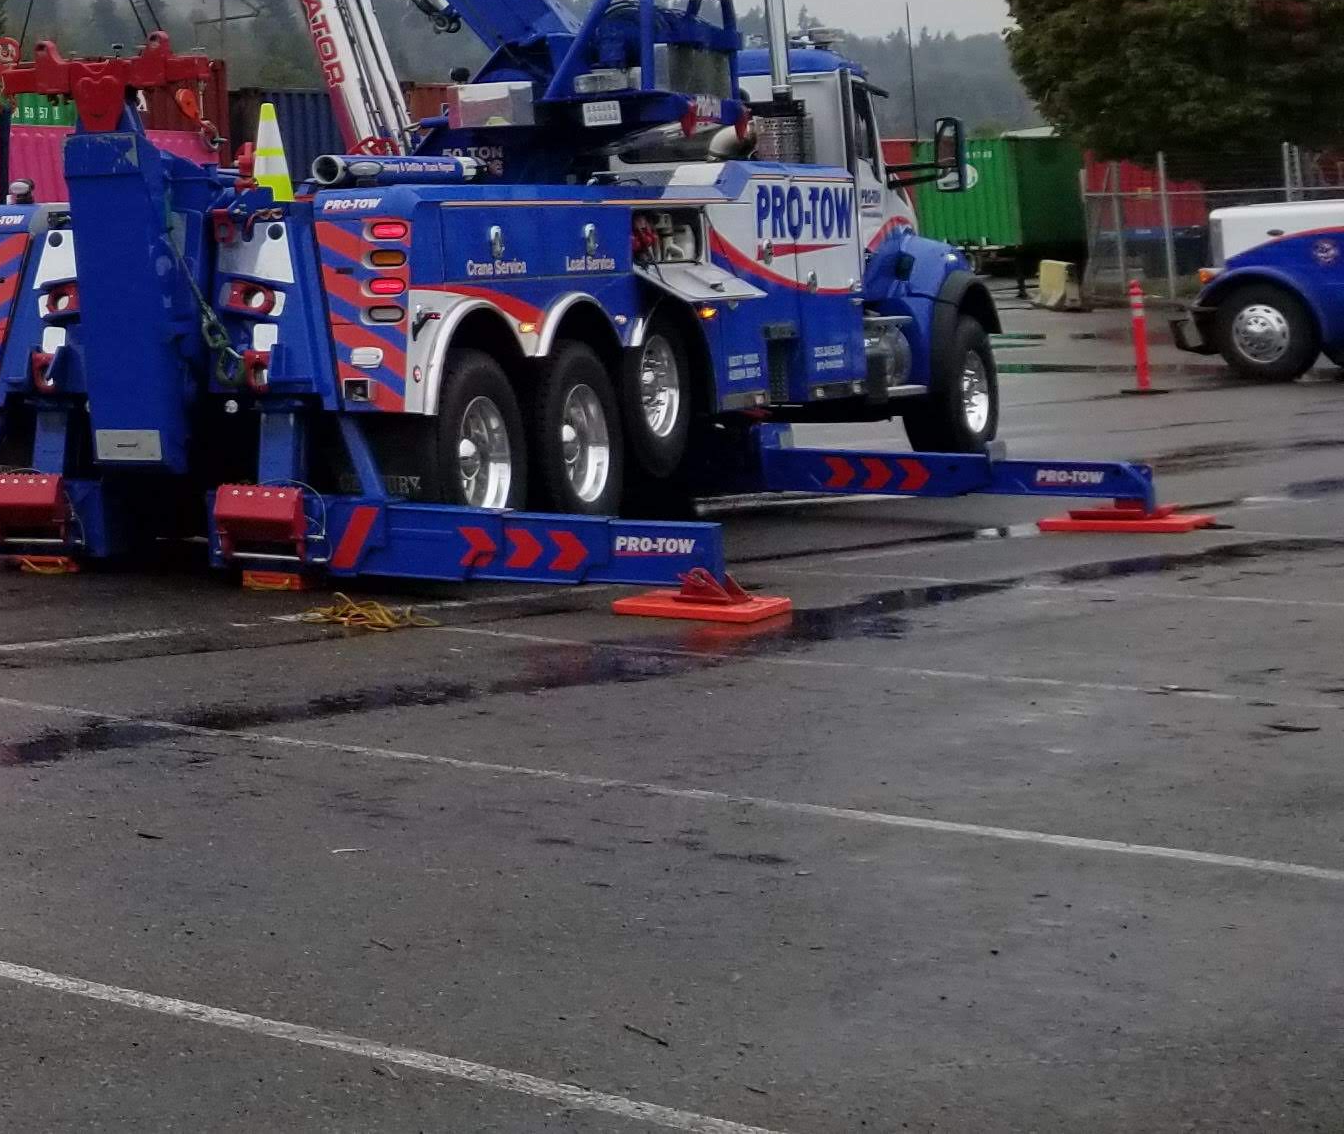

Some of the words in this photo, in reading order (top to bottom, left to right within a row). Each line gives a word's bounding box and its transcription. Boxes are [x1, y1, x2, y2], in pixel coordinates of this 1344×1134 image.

[324, 197, 382, 210] PRO-TOW
[757, 185, 854, 239] PRO-TOW
[467, 260, 494, 276] Crane
[1036, 468, 1104, 485] PRO-TOW
[615, 537, 696, 555] PRO-TOW
